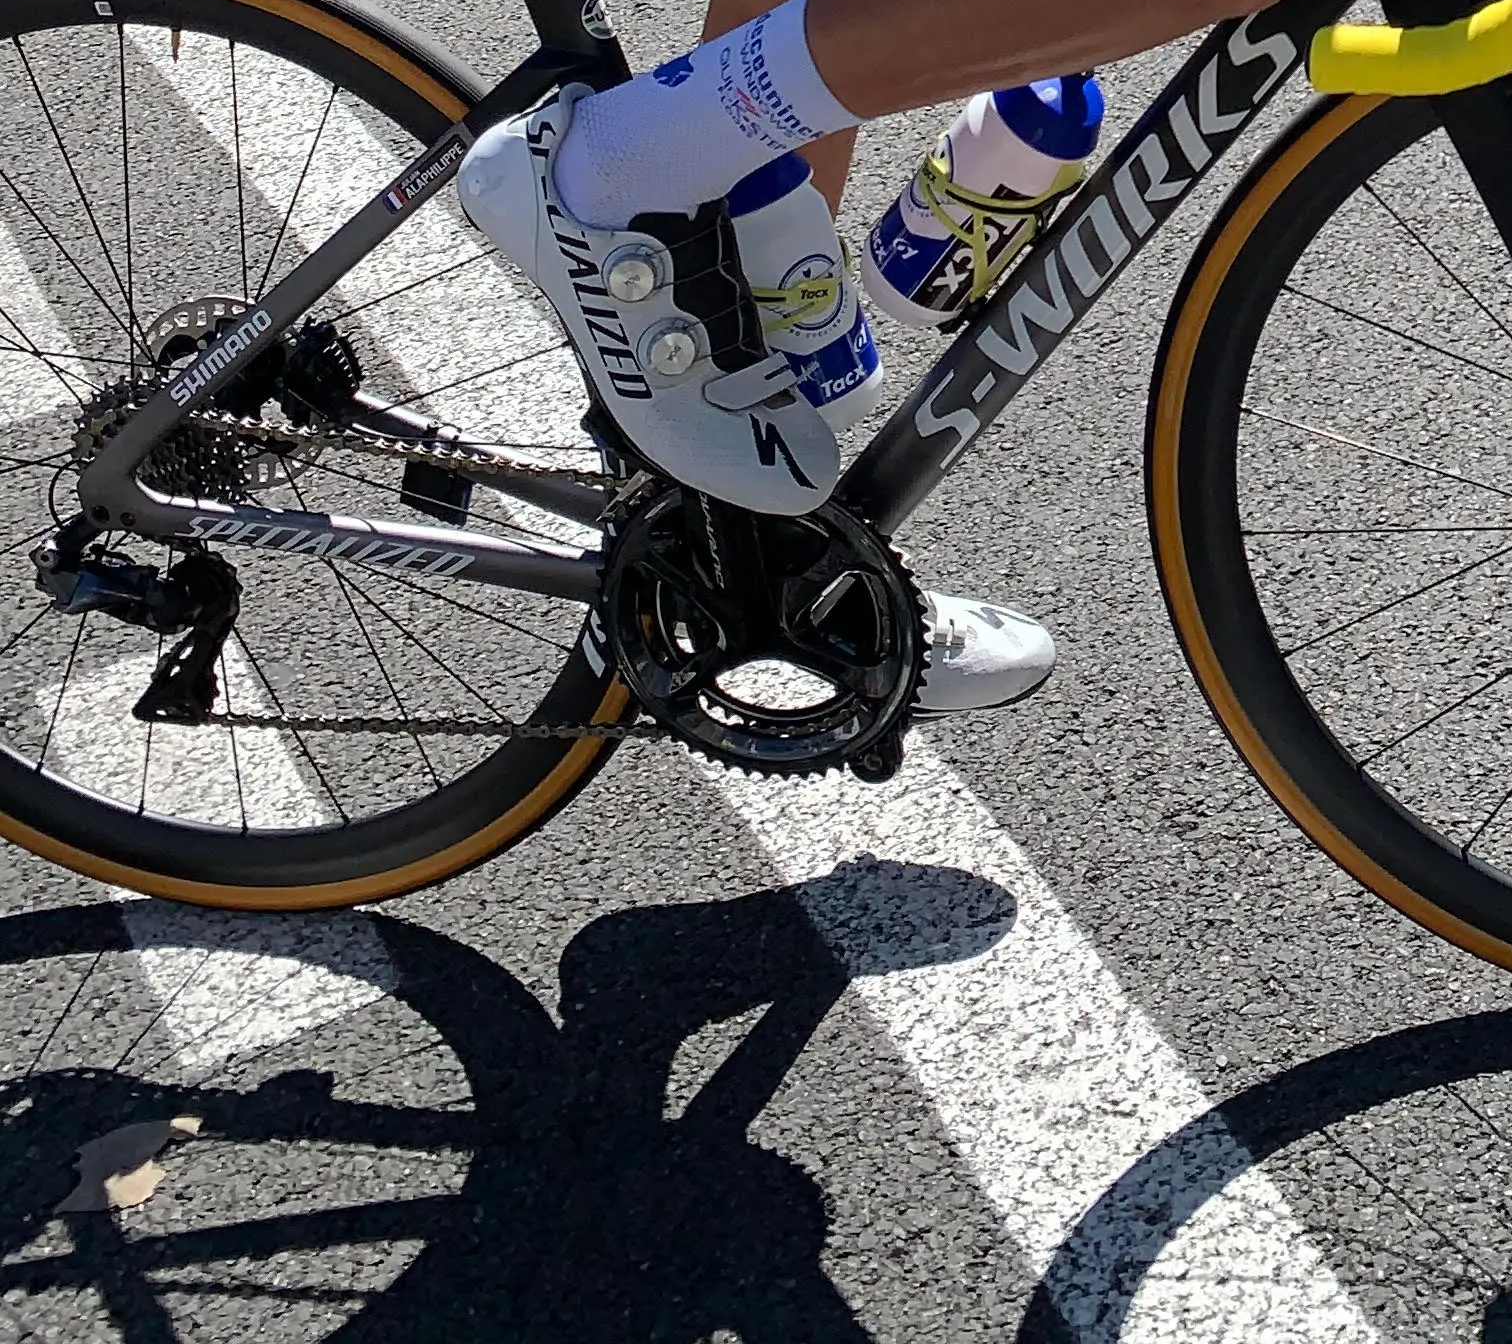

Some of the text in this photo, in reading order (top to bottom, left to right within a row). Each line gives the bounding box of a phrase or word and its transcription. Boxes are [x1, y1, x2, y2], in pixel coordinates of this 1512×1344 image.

[404, 142, 465, 200] ALAPHILIPPE
[915, 11, 1299, 470] S-WORKS
[801, 288, 829, 300] Tacx
[170, 309, 273, 407] SHIMANO
[821, 362, 867, 398] Tacx
[182, 513, 476, 578] SPECIALIZED
